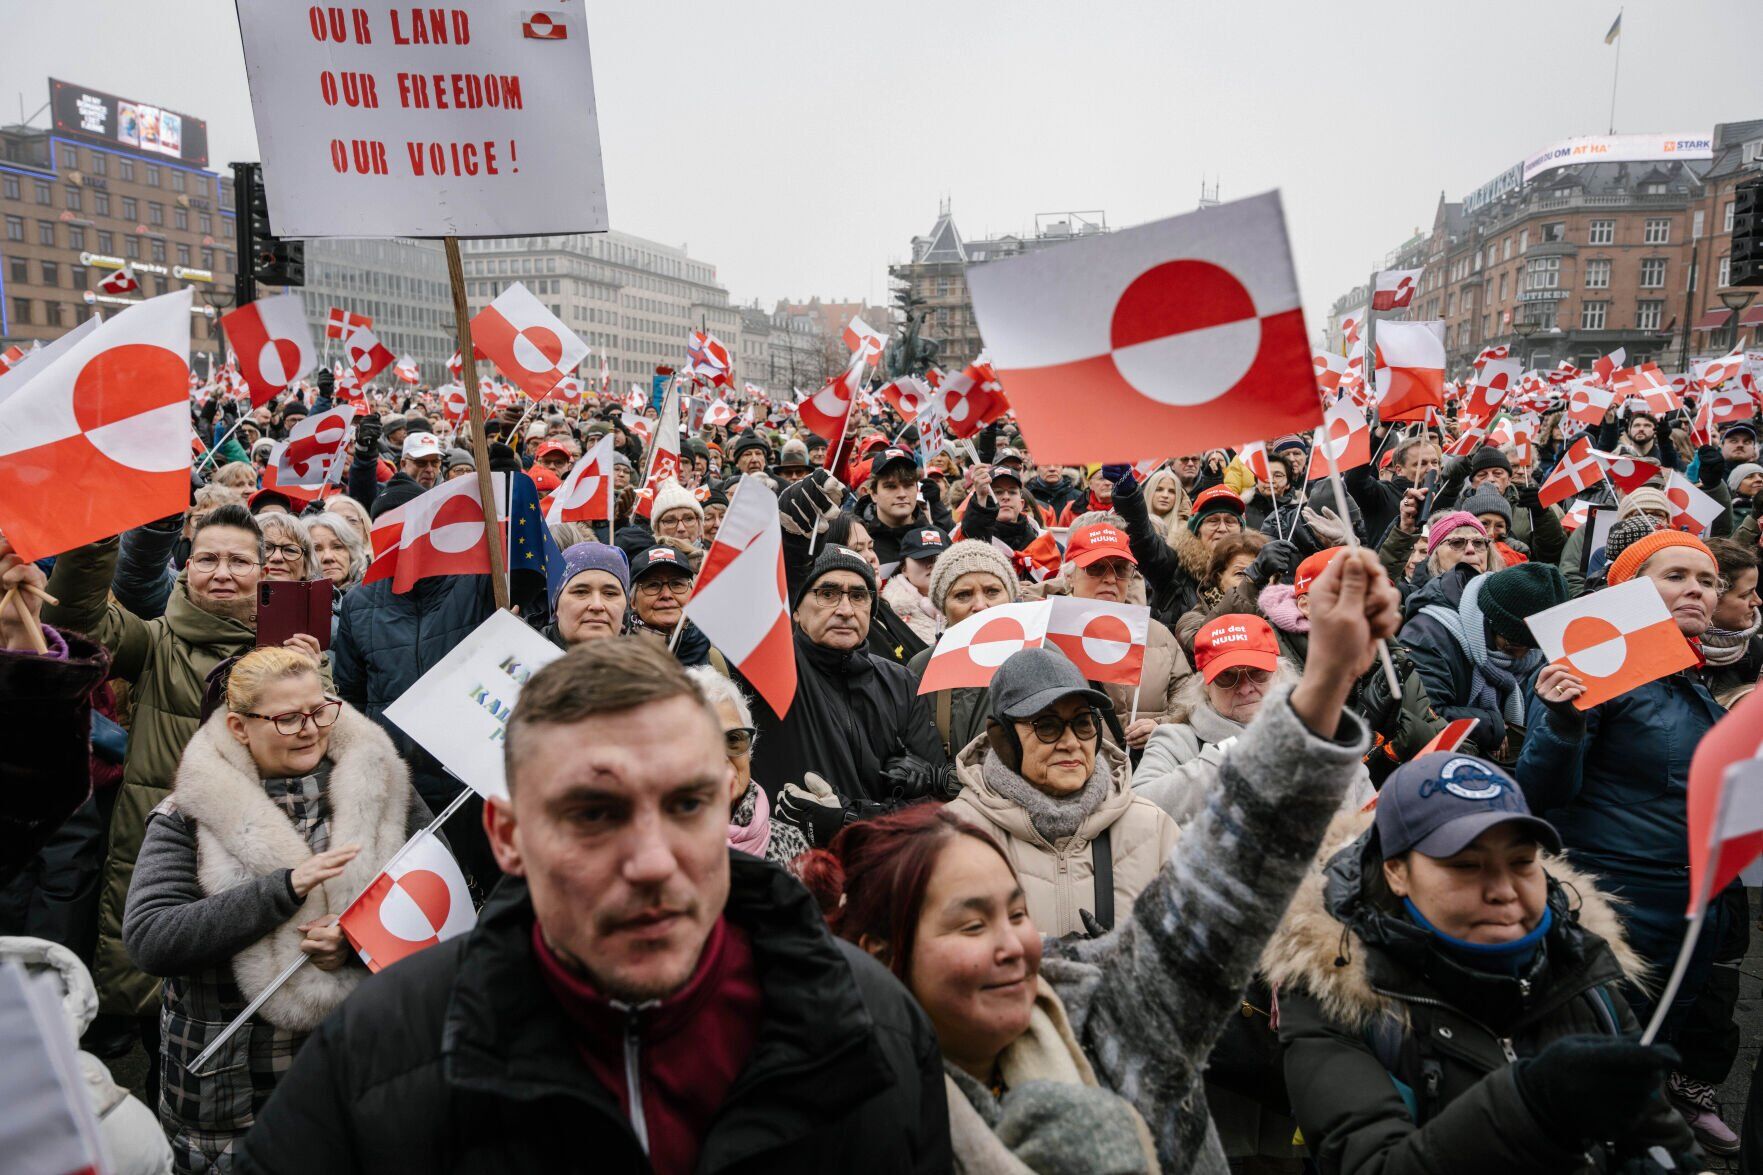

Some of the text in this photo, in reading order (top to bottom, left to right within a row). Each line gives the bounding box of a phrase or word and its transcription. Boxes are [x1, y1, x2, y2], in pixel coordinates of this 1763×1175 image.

[309, 6, 470, 45] OUR LAND
[320, 71, 523, 110] OUR FREEDOM
[1677, 140, 1710, 149] STARK
[330, 139, 389, 175] OUR
[407, 141, 499, 176] VOICE
[1554, 147, 1571, 159] OM
[1090, 535, 1118, 544] NUUK!
[1211, 625, 1247, 637] Nu det
[1212, 634, 1249, 647] NUUK!
